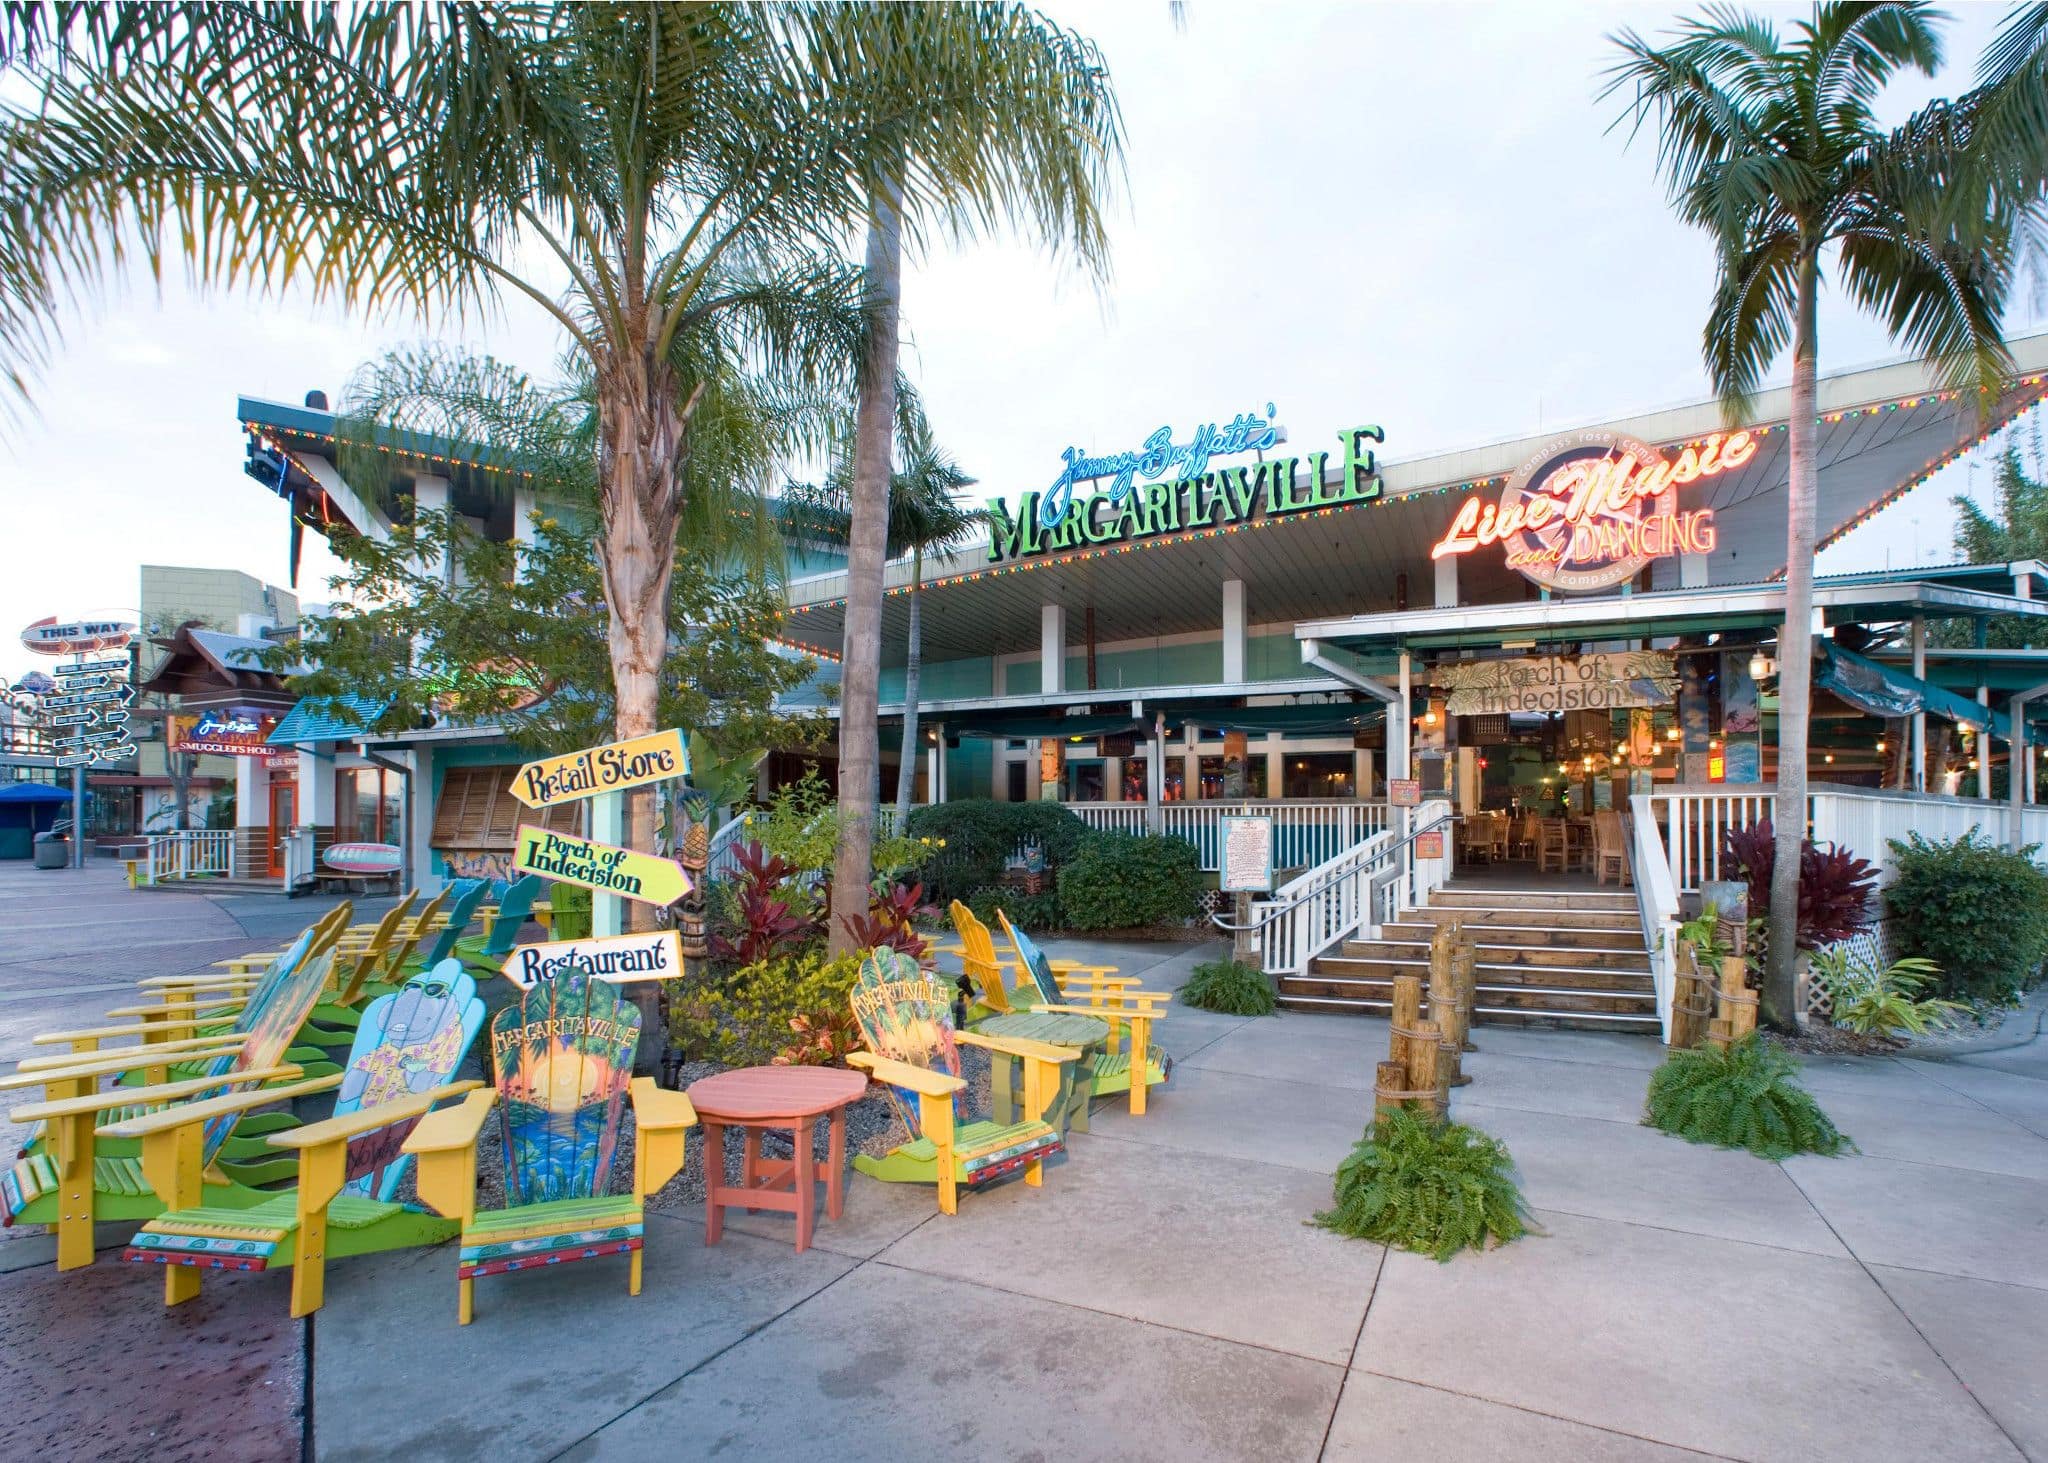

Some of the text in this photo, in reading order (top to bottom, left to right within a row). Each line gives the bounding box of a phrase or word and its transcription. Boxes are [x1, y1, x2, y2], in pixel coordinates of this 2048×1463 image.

[1041, 402, 1277, 529] Jimmy Buffett's
[1519, 432, 1656, 477] compass rose comp
[986, 424, 1385, 562] MARGARITAVILLE
[1431, 430, 1758, 560] Live Music
[1507, 509, 1717, 566] and DANCING
[1561, 568, 1624, 586] compass
[41, 623, 122, 639] THIS WAY
[1496, 655, 1607, 688] Porch of
[1480, 684, 1622, 713] Indecision
[180, 743, 276, 755] SMUGGLER'S HOLD
[523, 748, 675, 802] Retail Store
[526, 840, 642, 895] Indecision
[544, 834, 627, 868] Porch of
[518, 938, 667, 983] Restaurant
[494, 1015, 640, 1053] MARGARITAVILLE
